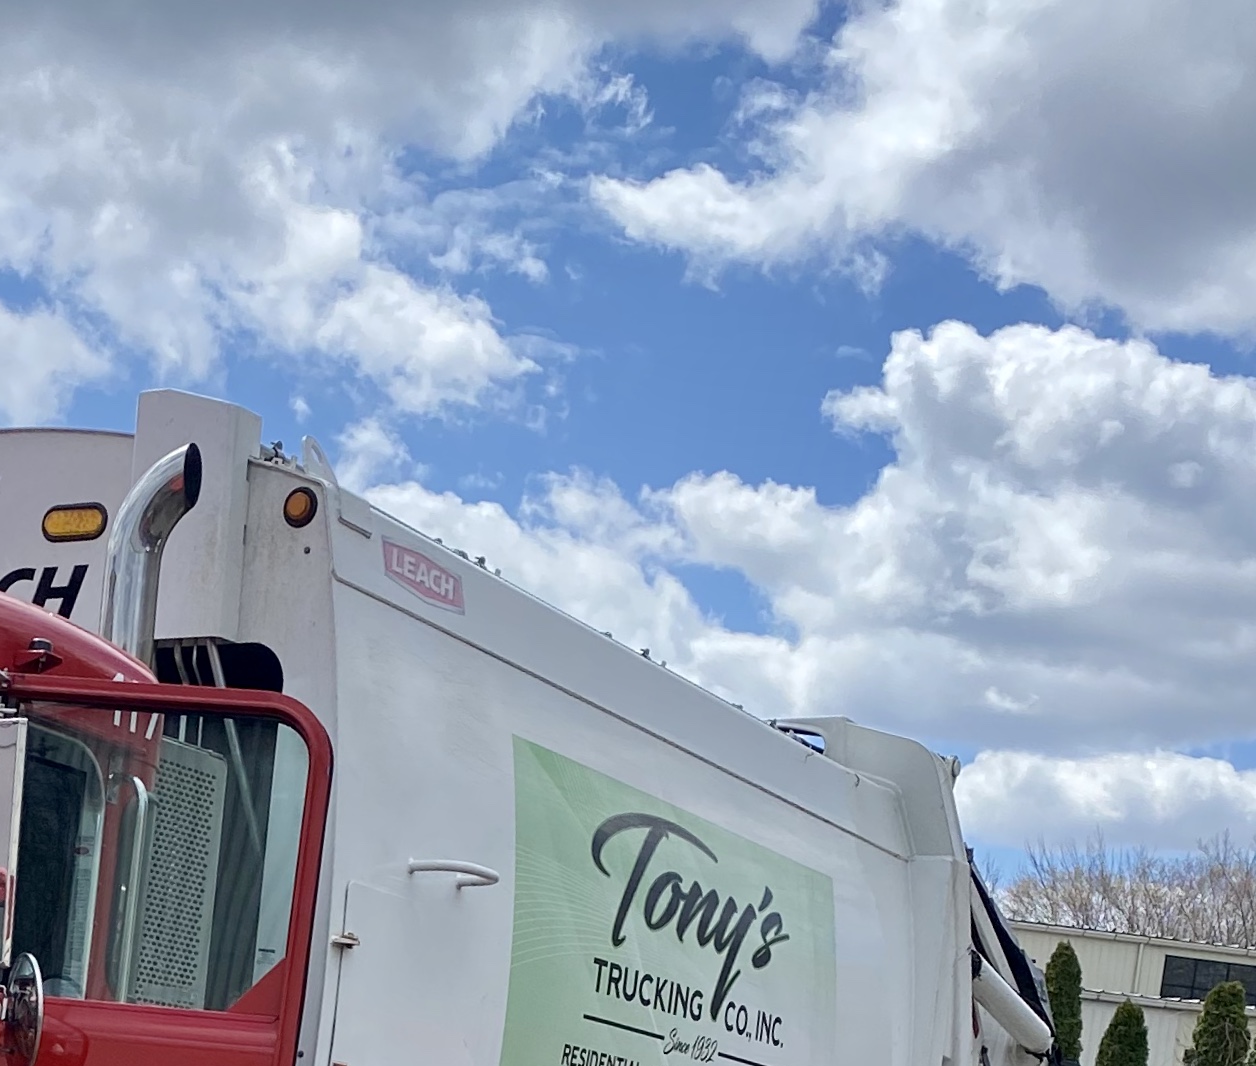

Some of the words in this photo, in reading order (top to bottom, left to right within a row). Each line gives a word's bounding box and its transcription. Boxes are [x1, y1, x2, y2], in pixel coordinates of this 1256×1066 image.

[391, 548, 454, 600] LEACH
[591, 812, 790, 1021] Tony's
[593, 957, 704, 1021] TRUCKING
[755, 1010, 784, 1048] INC.
[662, 1027, 690, 1055] Since
[690, 1035, 719, 1064] 1932
